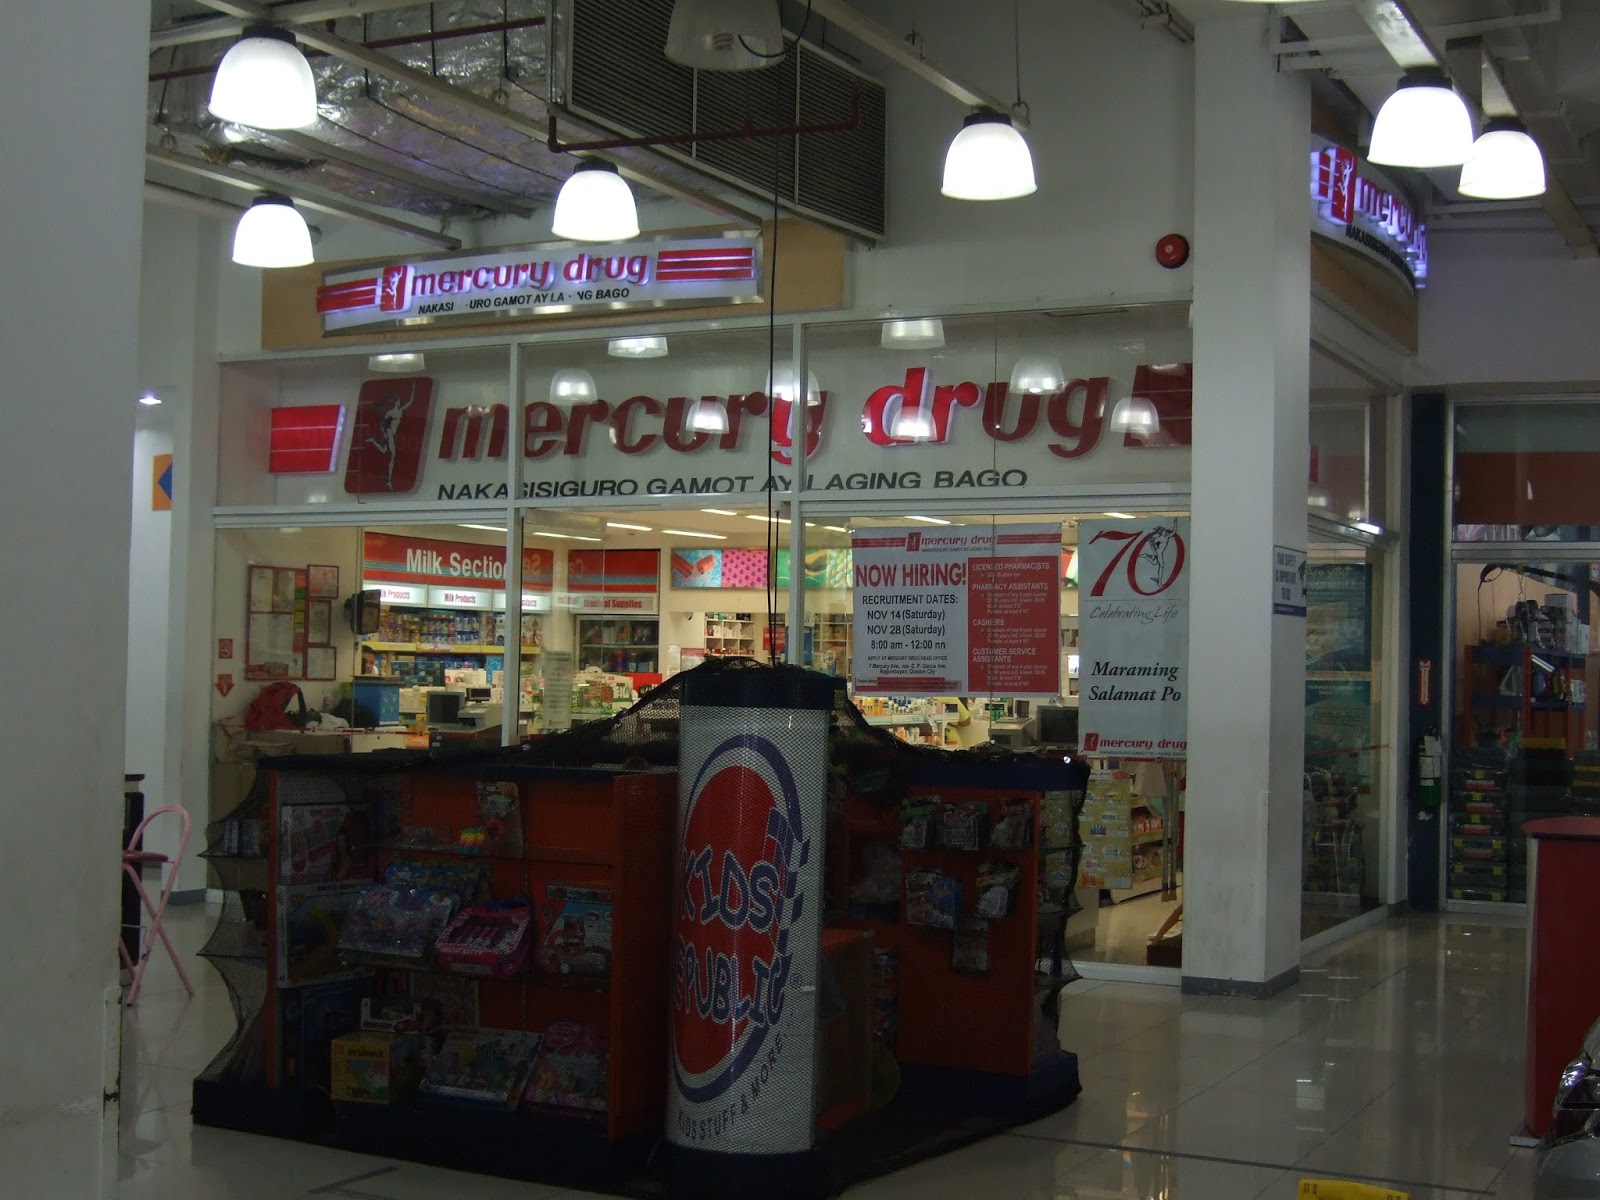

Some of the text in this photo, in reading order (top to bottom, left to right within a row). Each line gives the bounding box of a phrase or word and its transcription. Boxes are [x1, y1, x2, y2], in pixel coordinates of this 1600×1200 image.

[412, 253, 648, 296] mercury drug
[494, 295, 533, 307] GAMOT
[533, 293, 548, 304] AY
[596, 288, 630, 300] BAGO
[438, 367, 1108, 465] mercury drug
[647, 476, 753, 495] GAMOT
[761, 475, 792, 491] AY
[806, 471, 921, 490] LAGING
[934, 469, 1027, 488] BAGO
[921, 535, 996, 547] mercury drug
[406, 548, 506, 580] Milk Sectio
[1004, 562, 1050, 570] PHARMACISTS
[1088, 529, 1185, 597] 70
[855, 562, 967, 587] NOW HIRING!
[1008, 582, 1048, 590] ASSISTANTS
[388, 589, 411, 599] Products
[444, 592, 476, 604] Milk Products
[862, 594, 958, 604] RECRUITMENT DATES:
[612, 599, 642, 609] Supplies
[867, 609, 945, 622] NOV 14 (Saturday)
[1089, 604, 1178, 624] Celebrating Life
[867, 624, 945, 637] NOV 28 (Saturday)
[870, 640, 888, 650] 8:00
[890, 642, 903, 650] am
[911, 640, 933, 650] 12:00
[1008, 647, 1037, 655] SERVICE
[972, 655, 1011, 663] ASSISTANTS
[1091, 662, 1179, 681] Maraming
[1088, 685, 1181, 701] Salamat Po
[1100, 738, 1188, 751] mercury drug
[682, 844, 779, 934] KIDS
[673, 938, 792, 1027] PUBLIC
